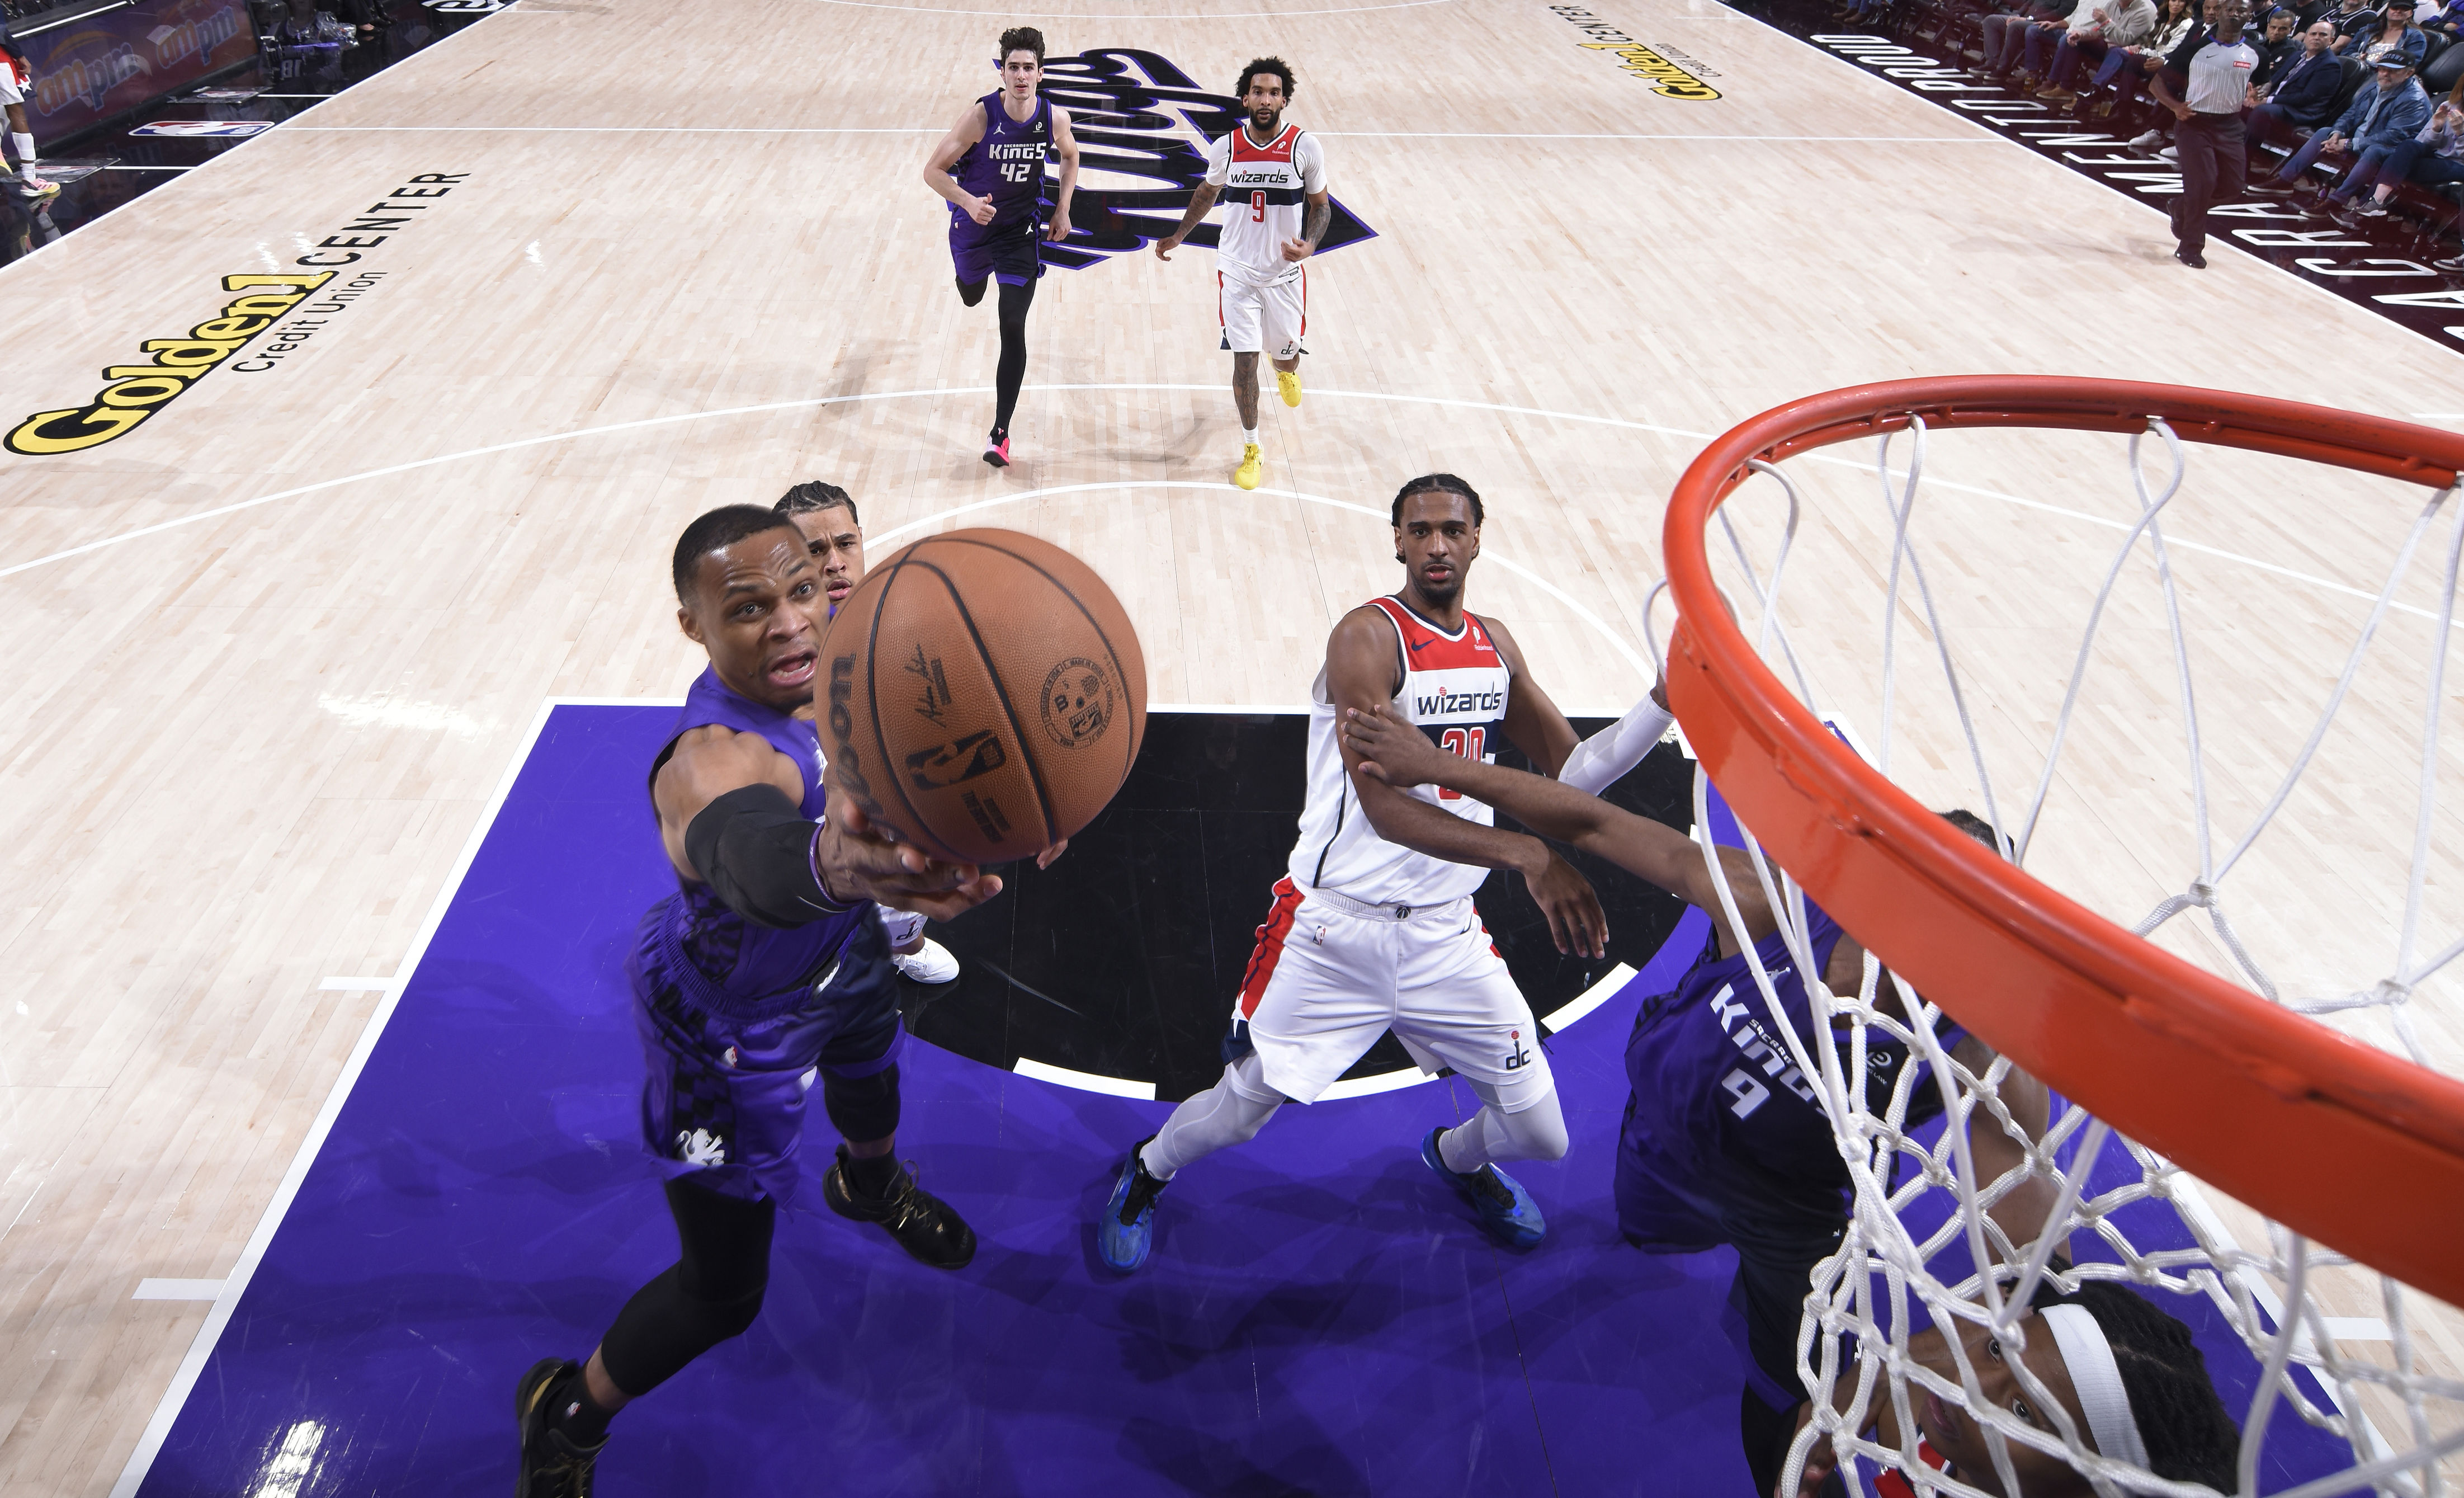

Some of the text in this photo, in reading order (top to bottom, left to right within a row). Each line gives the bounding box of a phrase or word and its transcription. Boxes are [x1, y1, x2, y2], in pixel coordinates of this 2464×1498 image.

[157, 6, 239, 69] ampm
[1549, 6, 1634, 41] CENTER
[36, 43, 140, 116] ampm
[1000, 163, 1031, 182] 42
[1231, 168, 1290, 183] wizards
[1810, 35, 2464, 340] ACRAMENTO PROUD
[296, 172, 471, 266] CENTER
[1252, 190, 1266, 223] 9
[232, 272, 388, 372] Credit Union
[1417, 681, 1503, 717] wizards
[1721, 1068, 1770, 1119] 9
